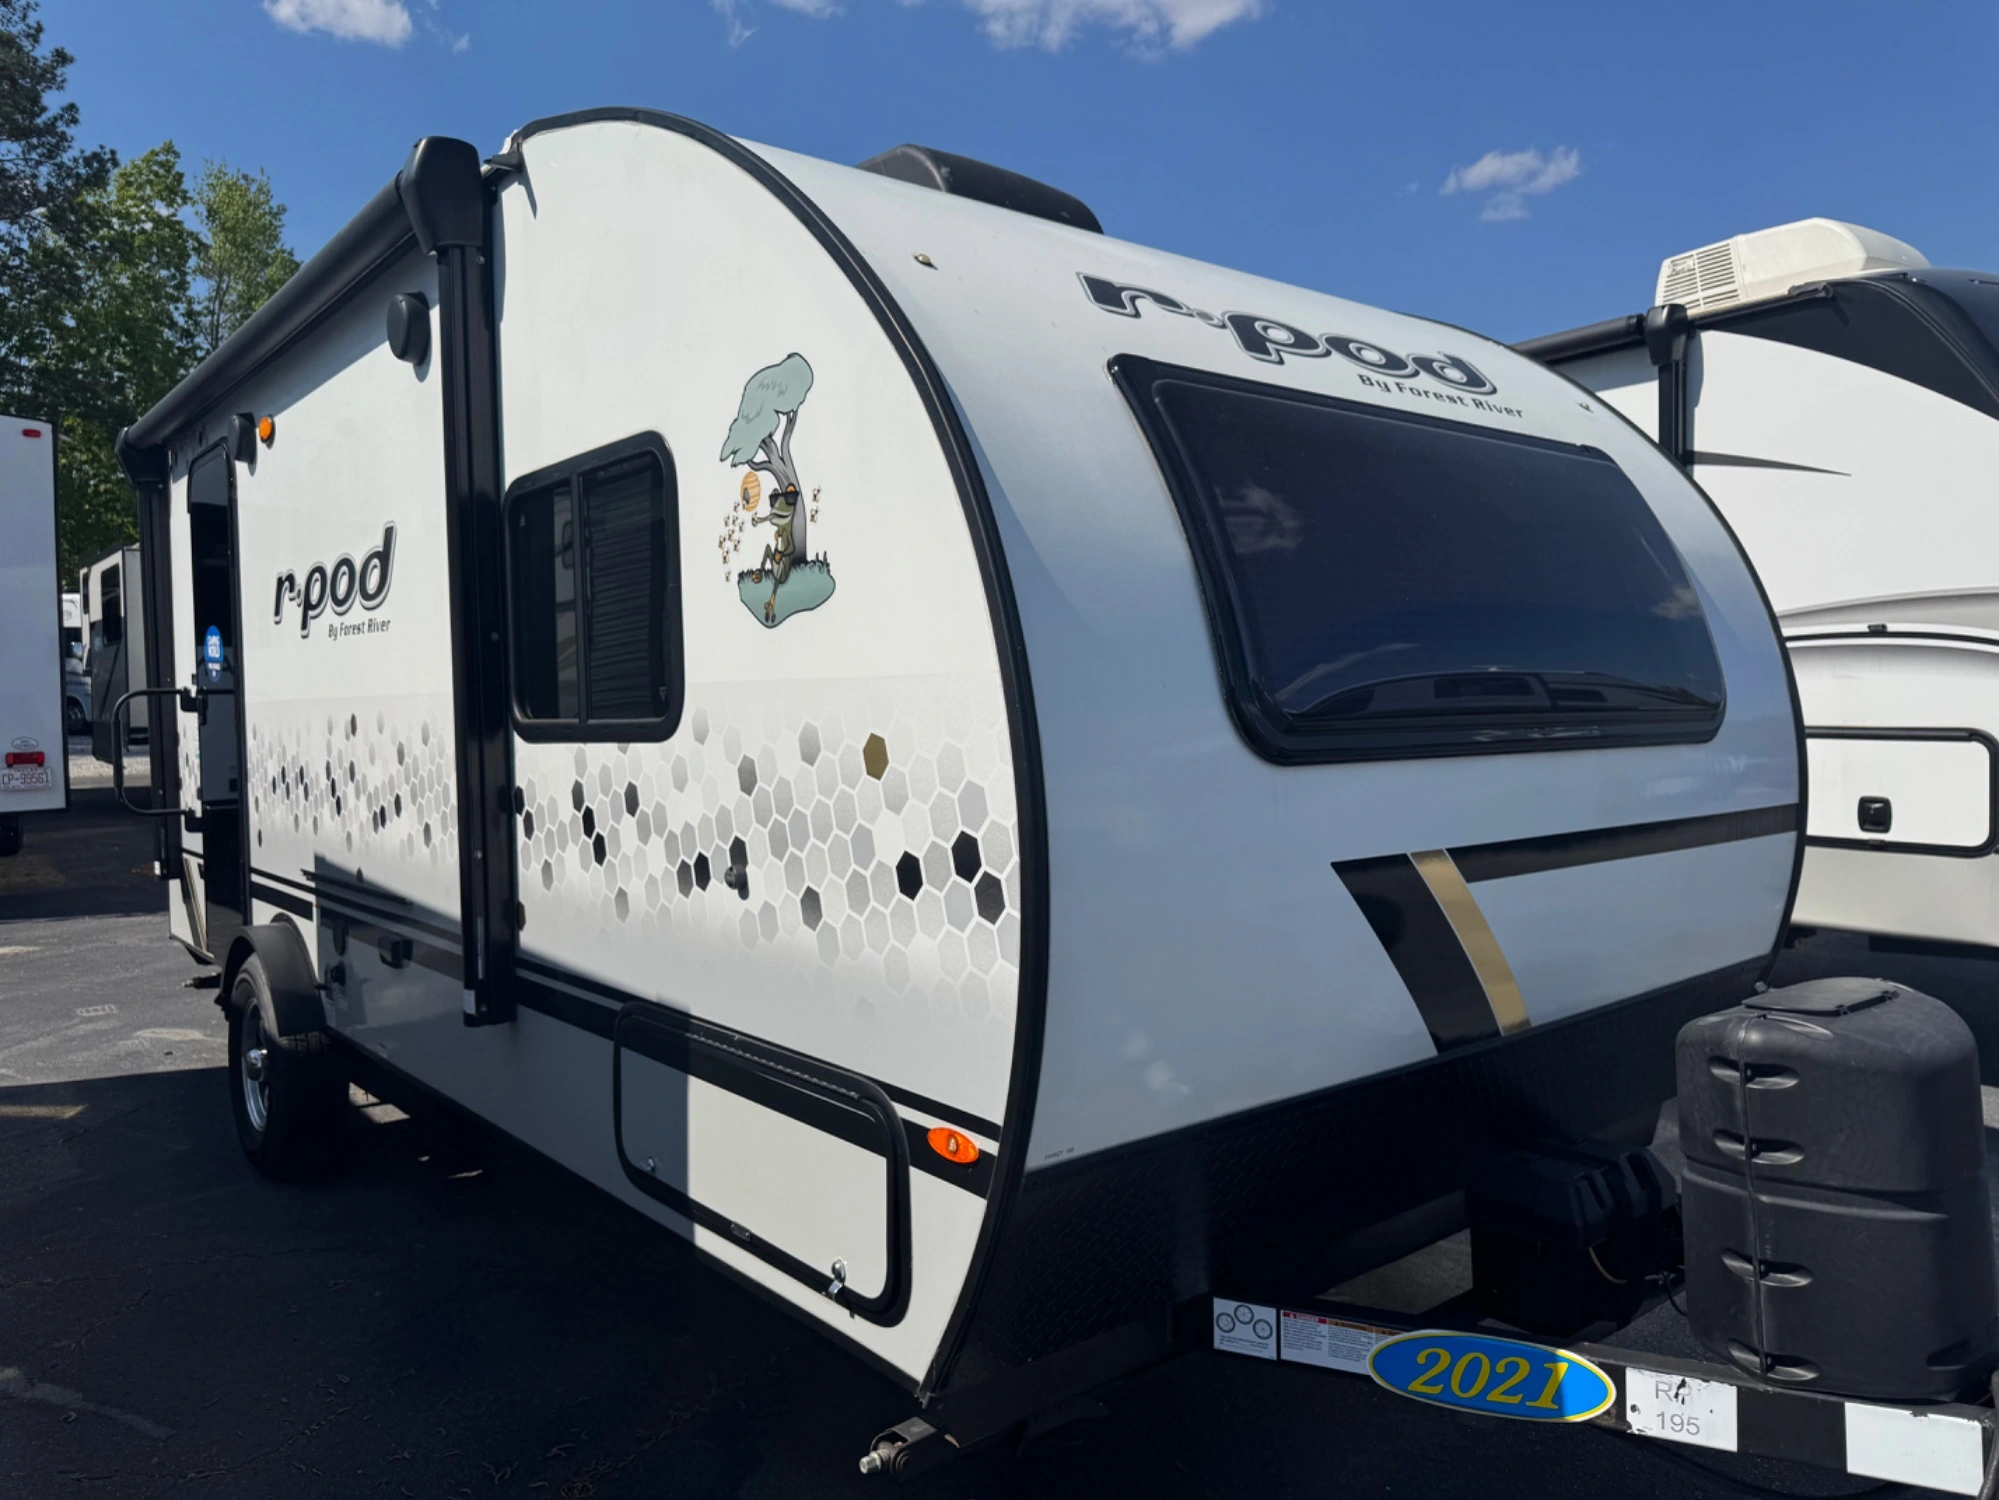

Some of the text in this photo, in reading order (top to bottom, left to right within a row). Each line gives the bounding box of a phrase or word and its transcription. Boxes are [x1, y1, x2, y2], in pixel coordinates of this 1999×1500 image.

[1358, 374, 1523, 418] By Forest River
[328, 618, 391, 641] By Forest River
[1407, 1347, 1569, 1410] 2021
[1656, 1411, 1700, 1436] 195
